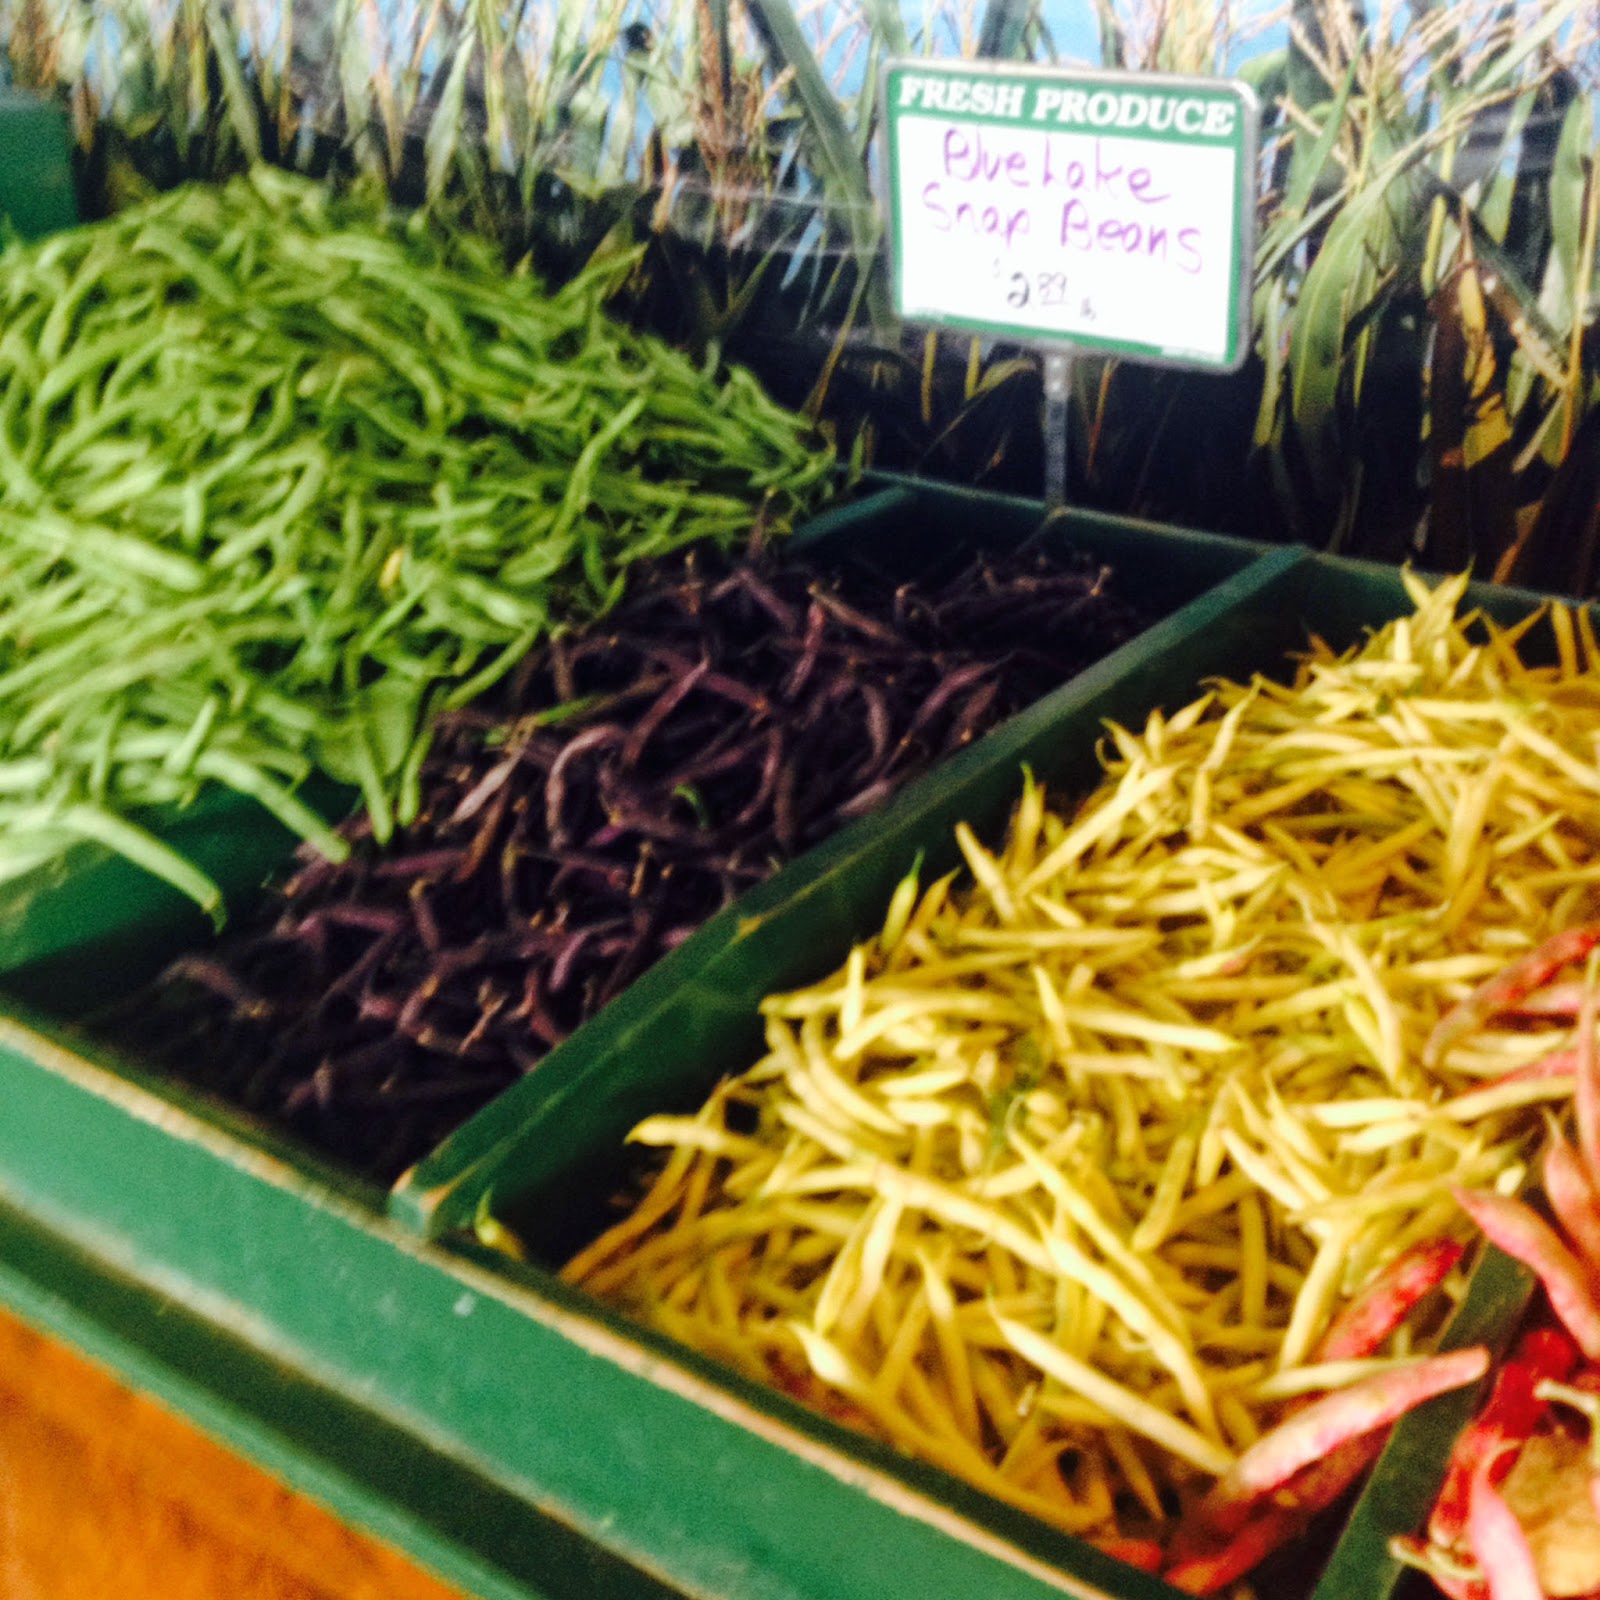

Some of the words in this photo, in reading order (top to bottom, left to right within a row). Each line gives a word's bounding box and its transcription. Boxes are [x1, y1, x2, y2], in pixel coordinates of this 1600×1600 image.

[898, 75, 1025, 118] FRESH
[1032, 88, 1237, 136] PRODUCE
[943, 127, 1031, 187] Blue
[1041, 133, 1172, 203] Lake
[921, 182, 1030, 247] Snap
[1060, 198, 1203, 274] Beans
